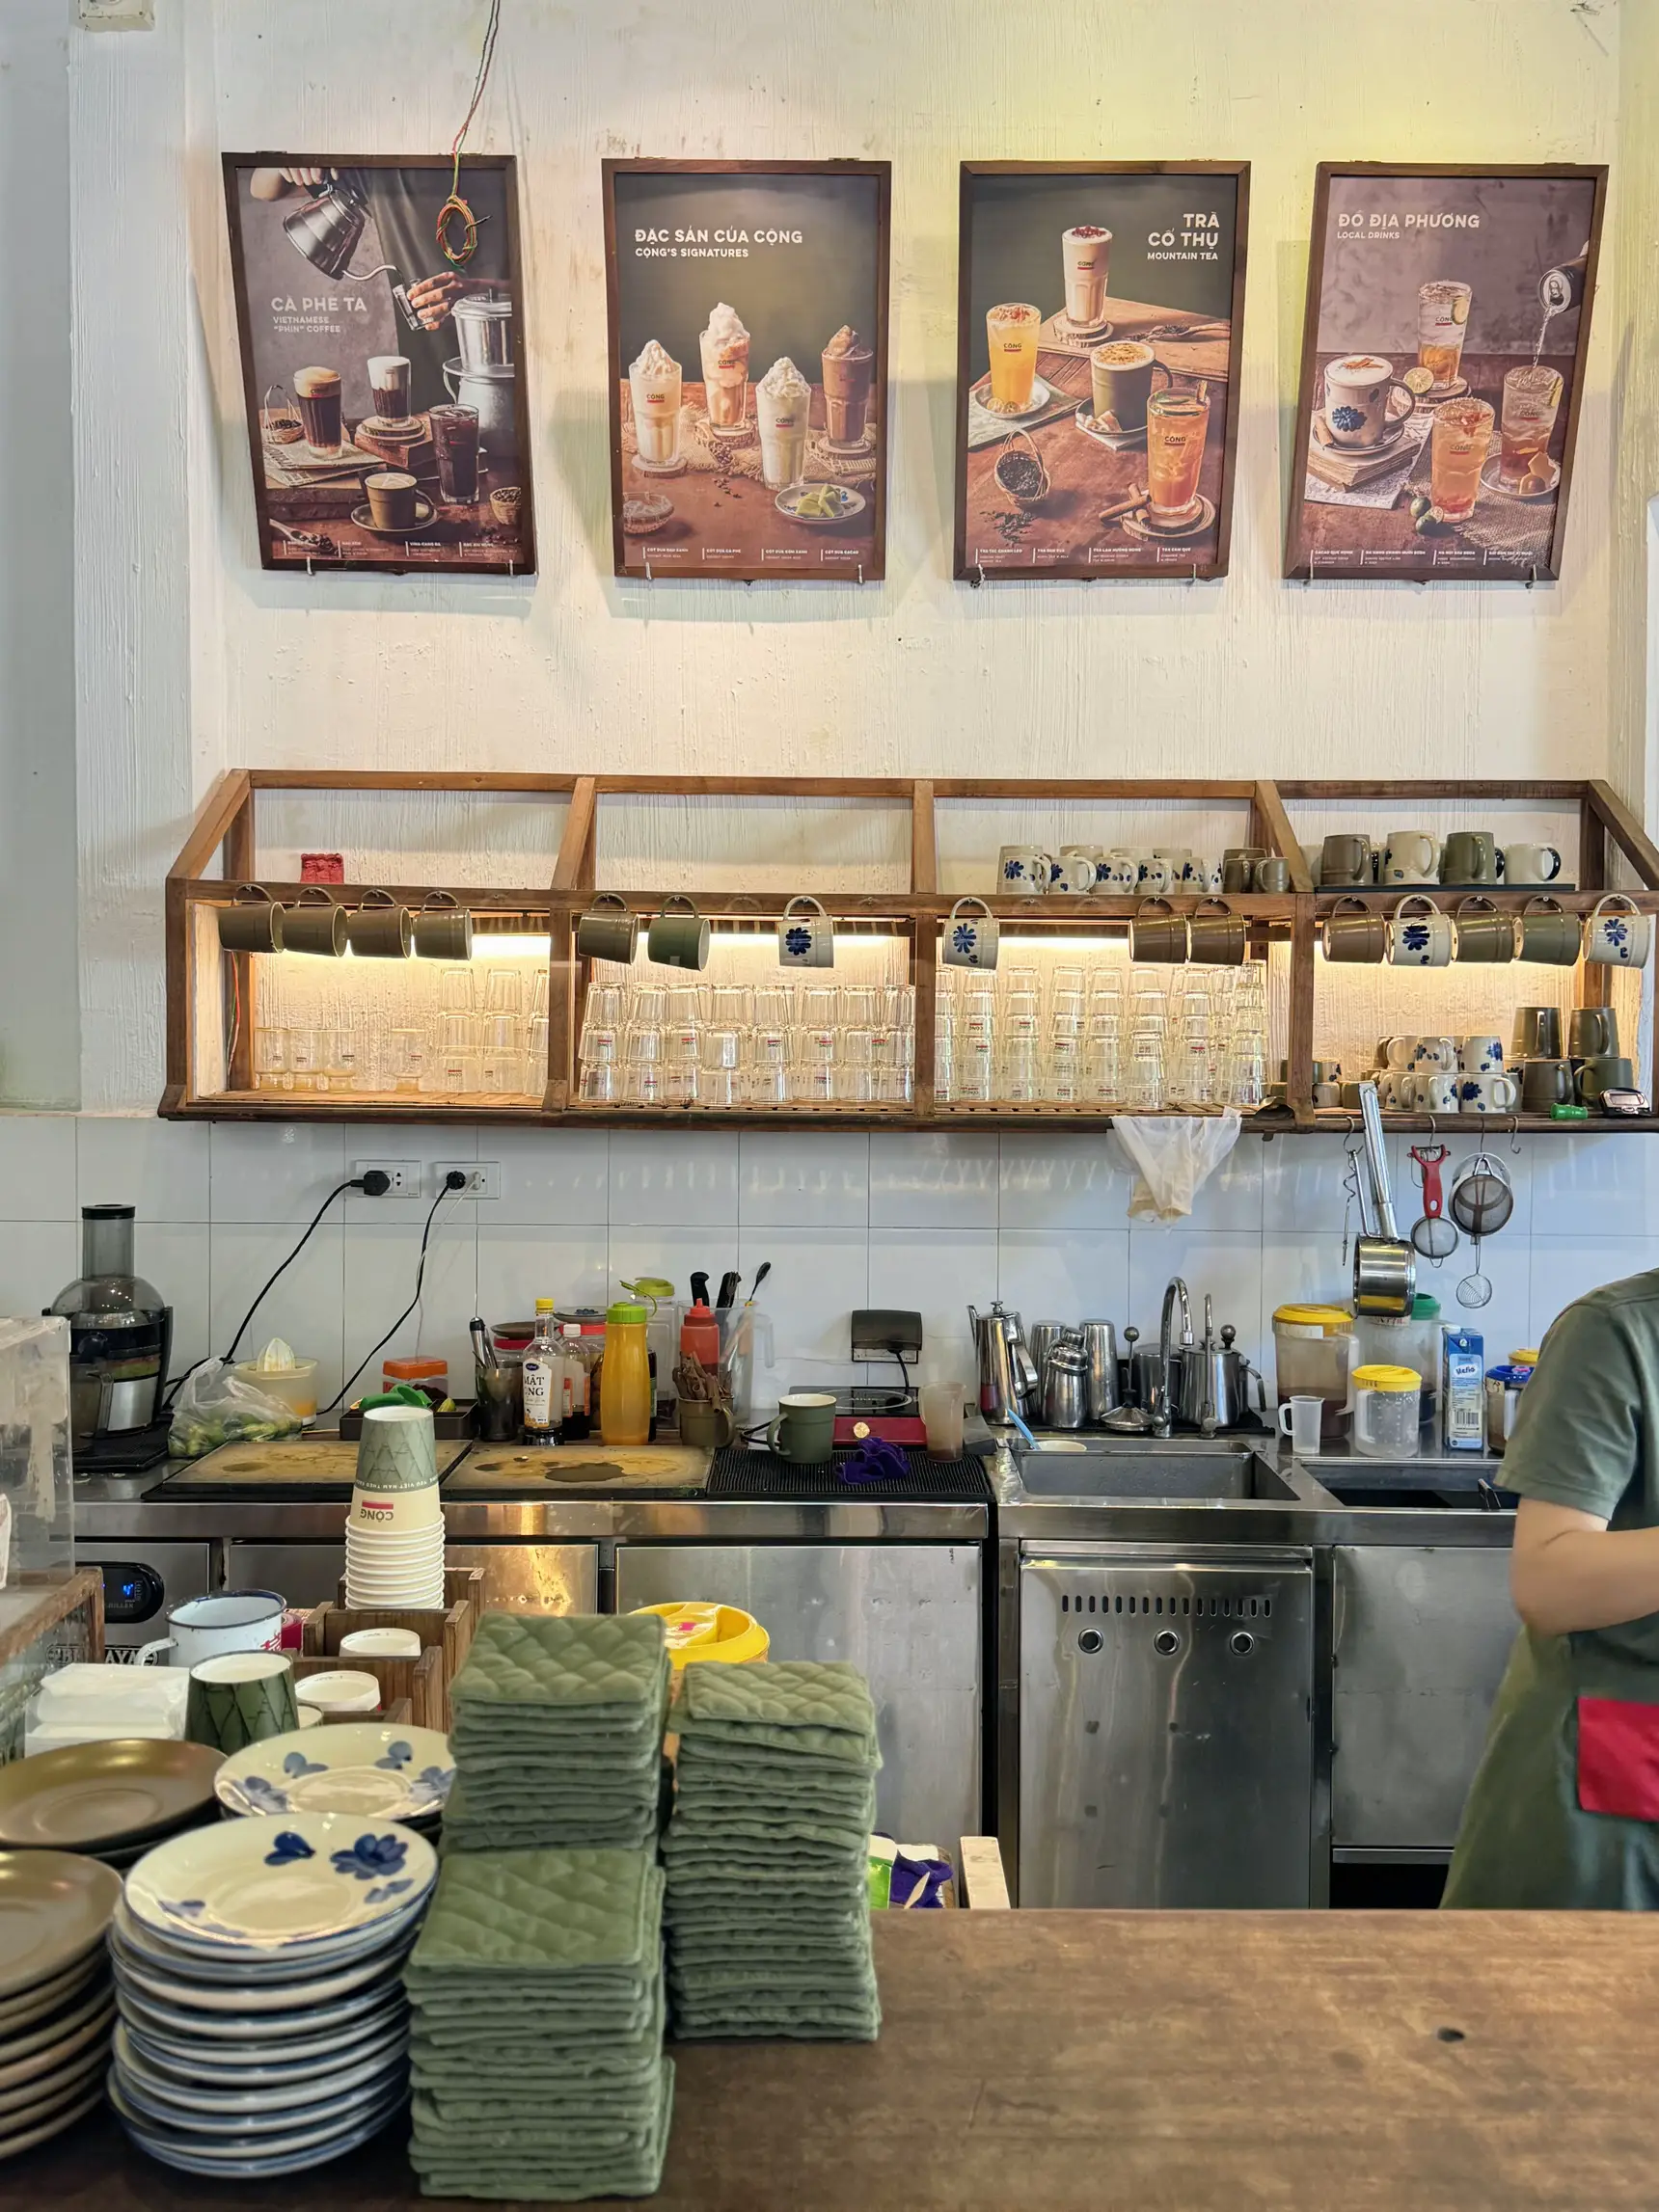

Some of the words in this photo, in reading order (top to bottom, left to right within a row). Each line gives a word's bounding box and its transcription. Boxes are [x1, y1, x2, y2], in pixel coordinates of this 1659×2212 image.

[1337, 230, 1366, 239] LOCAL
[1368, 230, 1401, 239] DRINKS
[680, 248, 749, 257] SIGNATURES
[1147, 252, 1198, 260] MOUNTAIN
[1200, 252, 1219, 260] TEA
[343, 297, 367, 311] TA
[273, 315, 330, 324] VIETNAMESE
